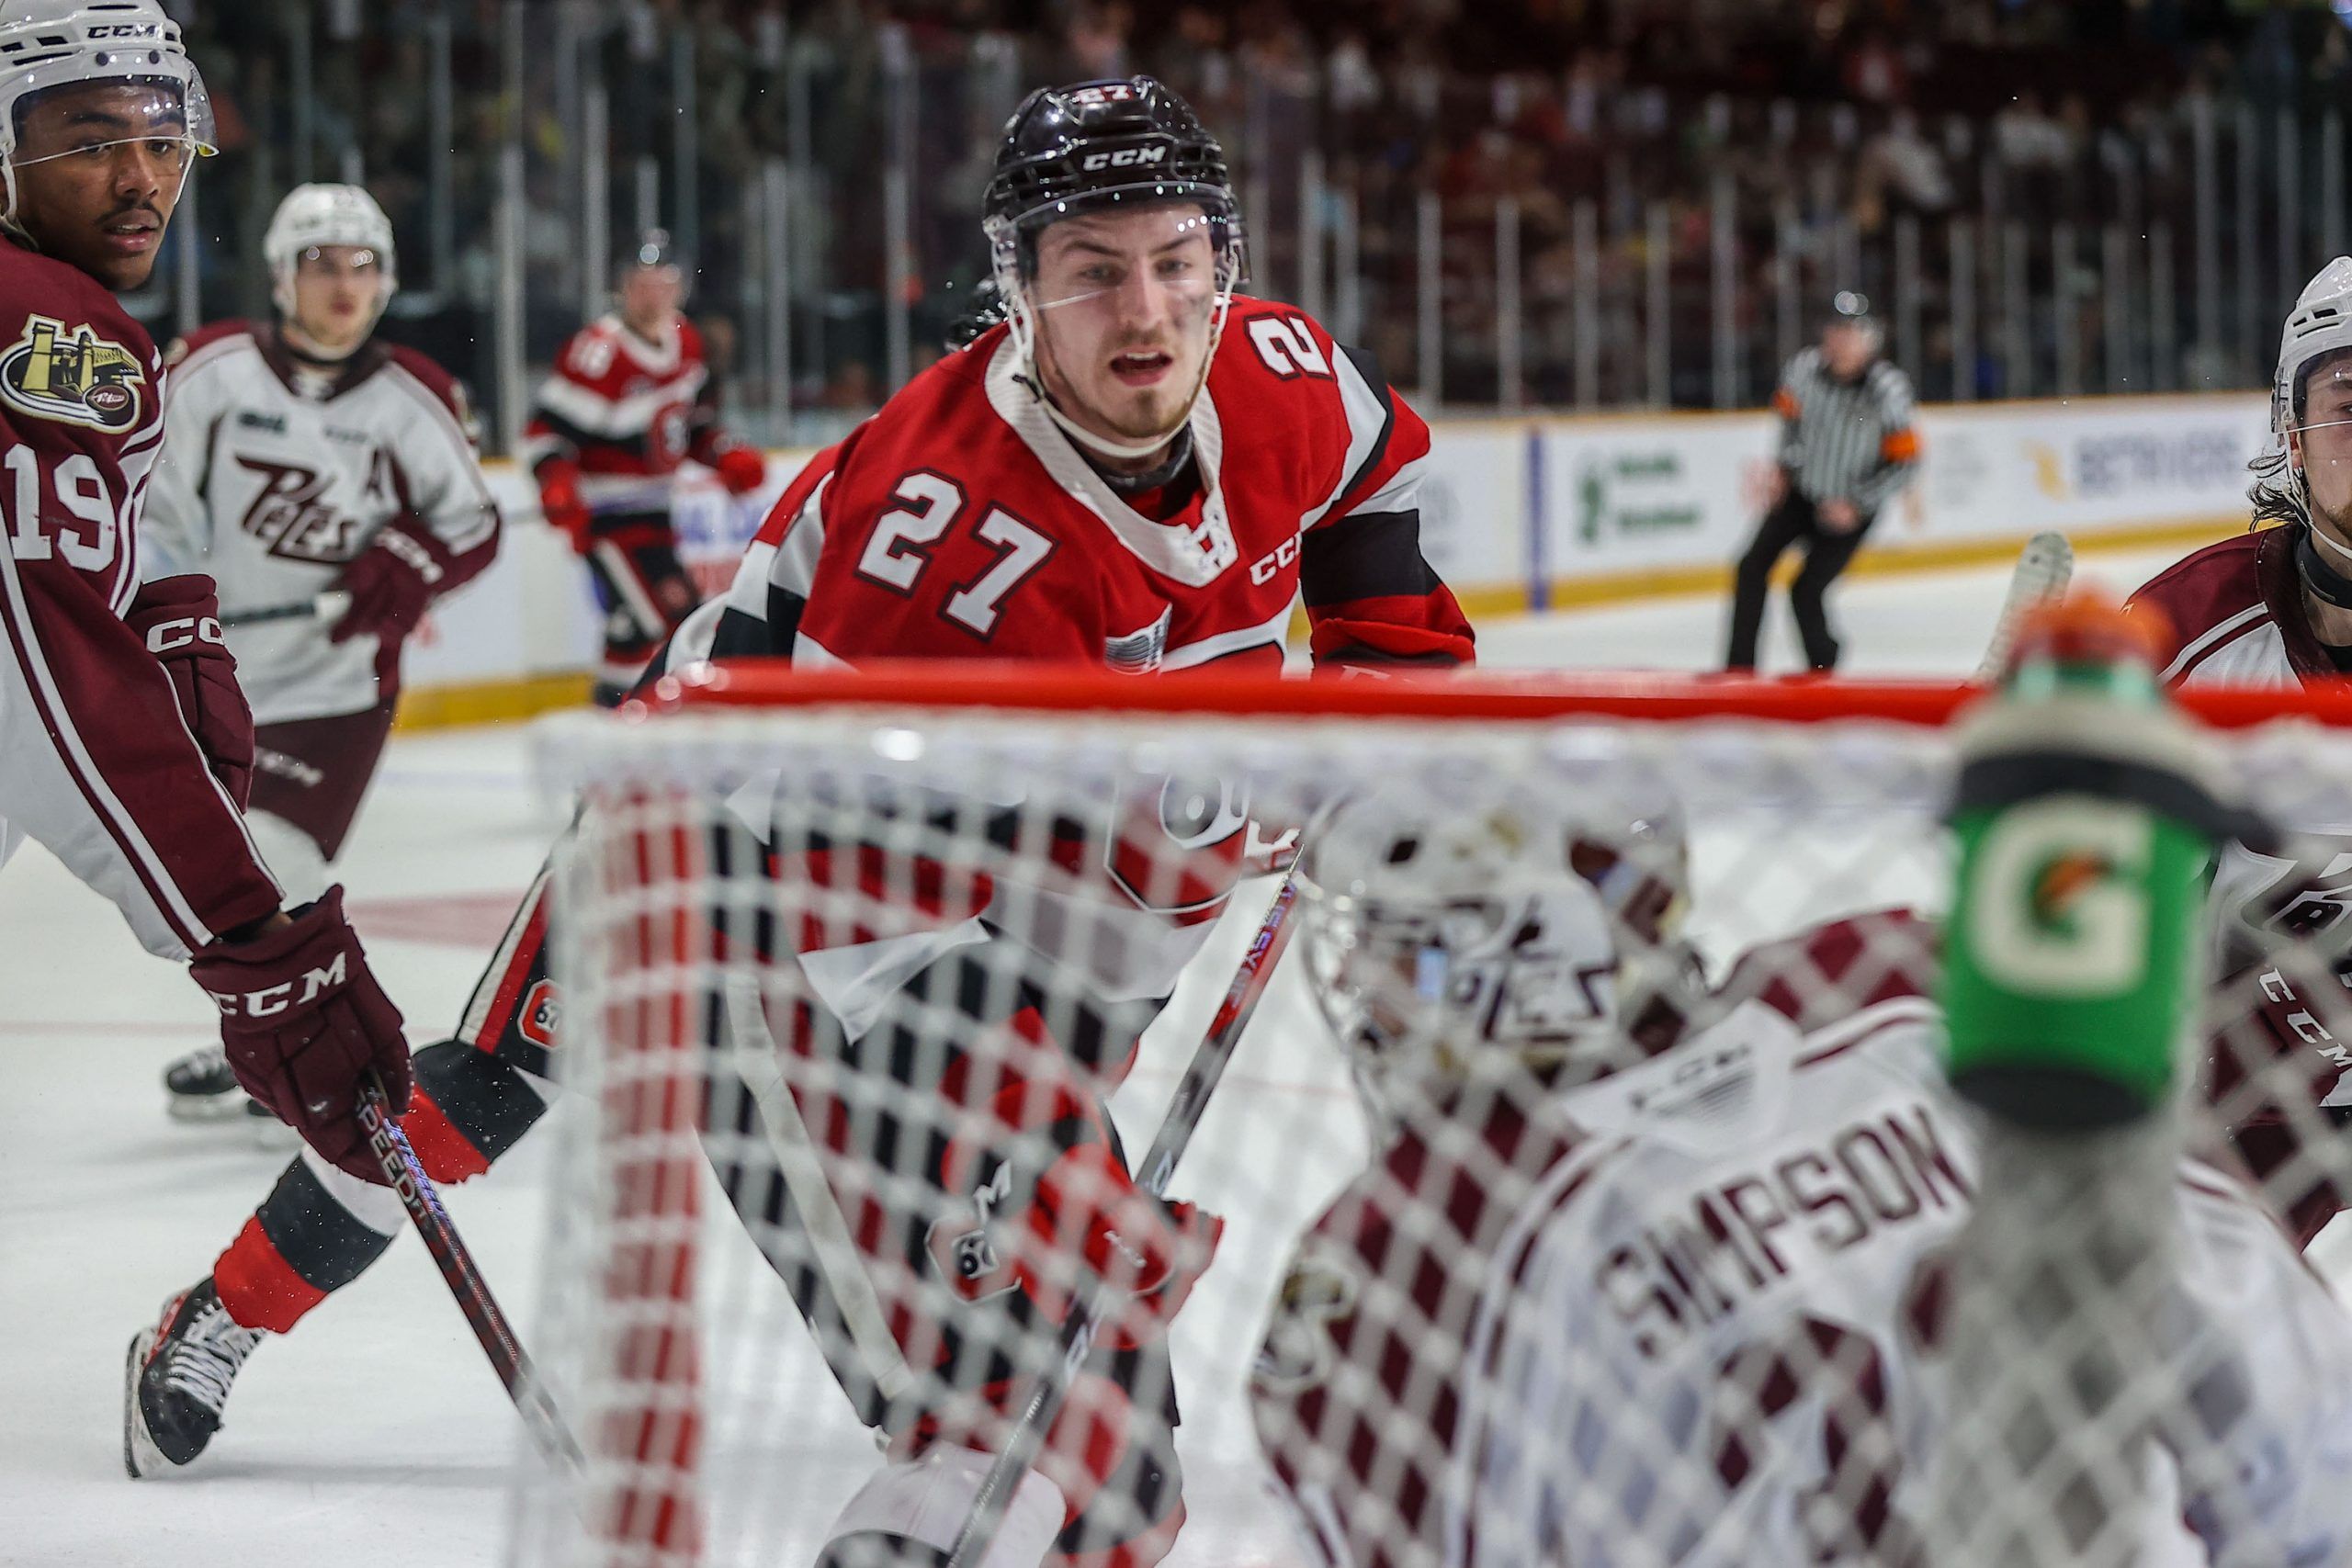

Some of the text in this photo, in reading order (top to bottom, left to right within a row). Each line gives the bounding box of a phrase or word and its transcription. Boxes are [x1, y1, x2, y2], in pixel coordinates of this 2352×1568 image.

[1076, 85, 1131, 104] 27
[1082, 145, 1167, 172] CCM
[5, 443, 116, 572] 19
[855, 468, 1060, 640] 27
[1969, 794, 2155, 996] G
[208, 951, 346, 1018] CCM
[2259, 967, 2352, 1069] CCM
[1595, 1102, 1973, 1359] SIMPSON
